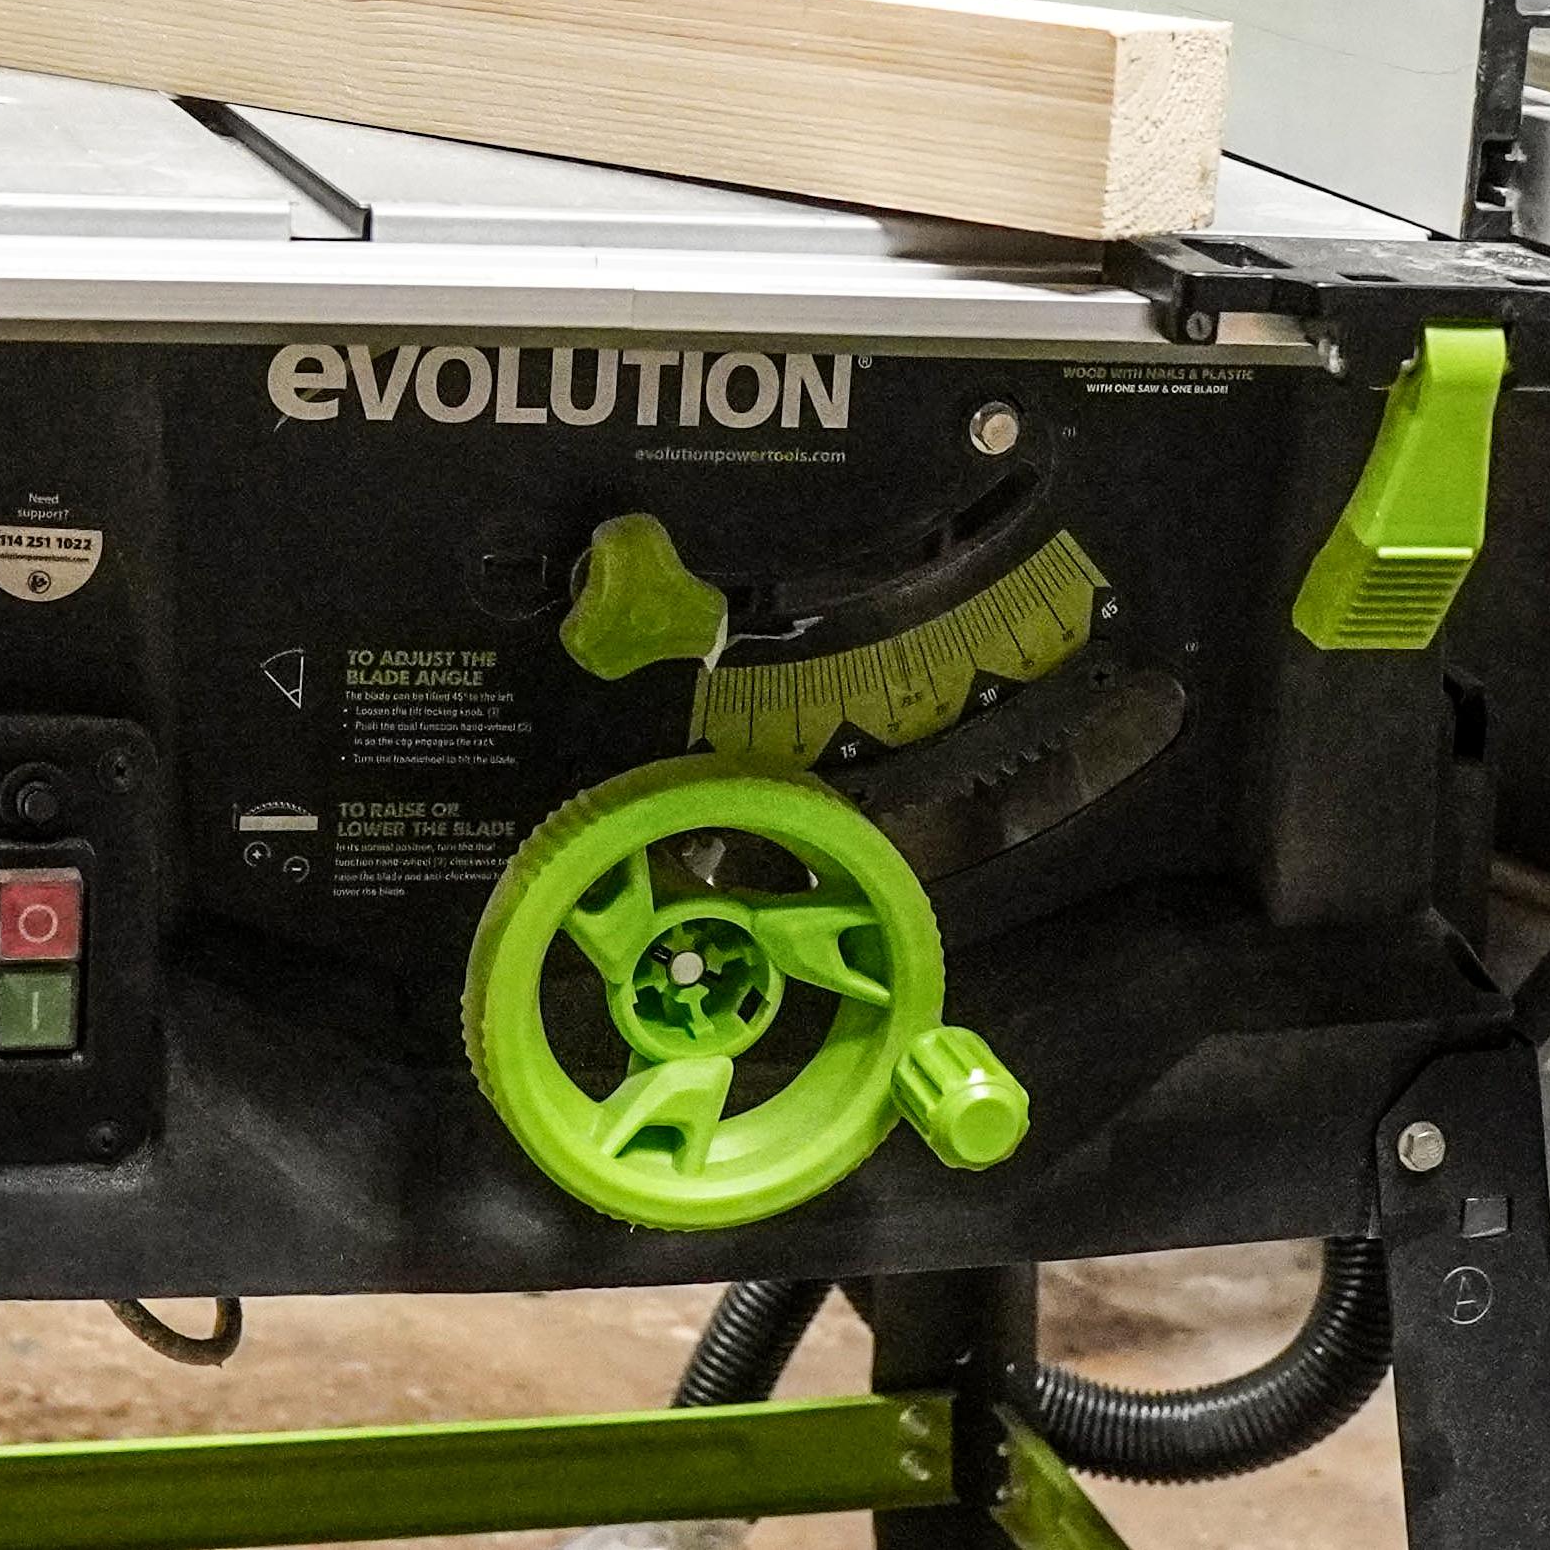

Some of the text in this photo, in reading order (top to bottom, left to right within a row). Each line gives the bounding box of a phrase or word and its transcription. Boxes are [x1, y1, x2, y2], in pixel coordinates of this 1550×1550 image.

[1062, 366, 1107, 380] WOOD
[1086, 384, 1113, 394] WITH
[1114, 384, 1136, 394] ONE
[1138, 384, 1161, 395] SAW
[1171, 384, 1193, 395] ONE
[635, 447, 846, 463] evolutionpowertools.com
[28, 492, 59, 504] Need
[17, 509, 70, 521] support?
[26, 536, 51, 548] 251
[56, 538, 92, 551] 1022
[347, 650, 498, 667] TO ADJUST THE
[346, 669, 484, 686] BLADE ANGLE
[338, 801, 365, 818] TO
[370, 801, 426, 818] RAISE
[338, 821, 516, 838] LOWER THE BLADE
